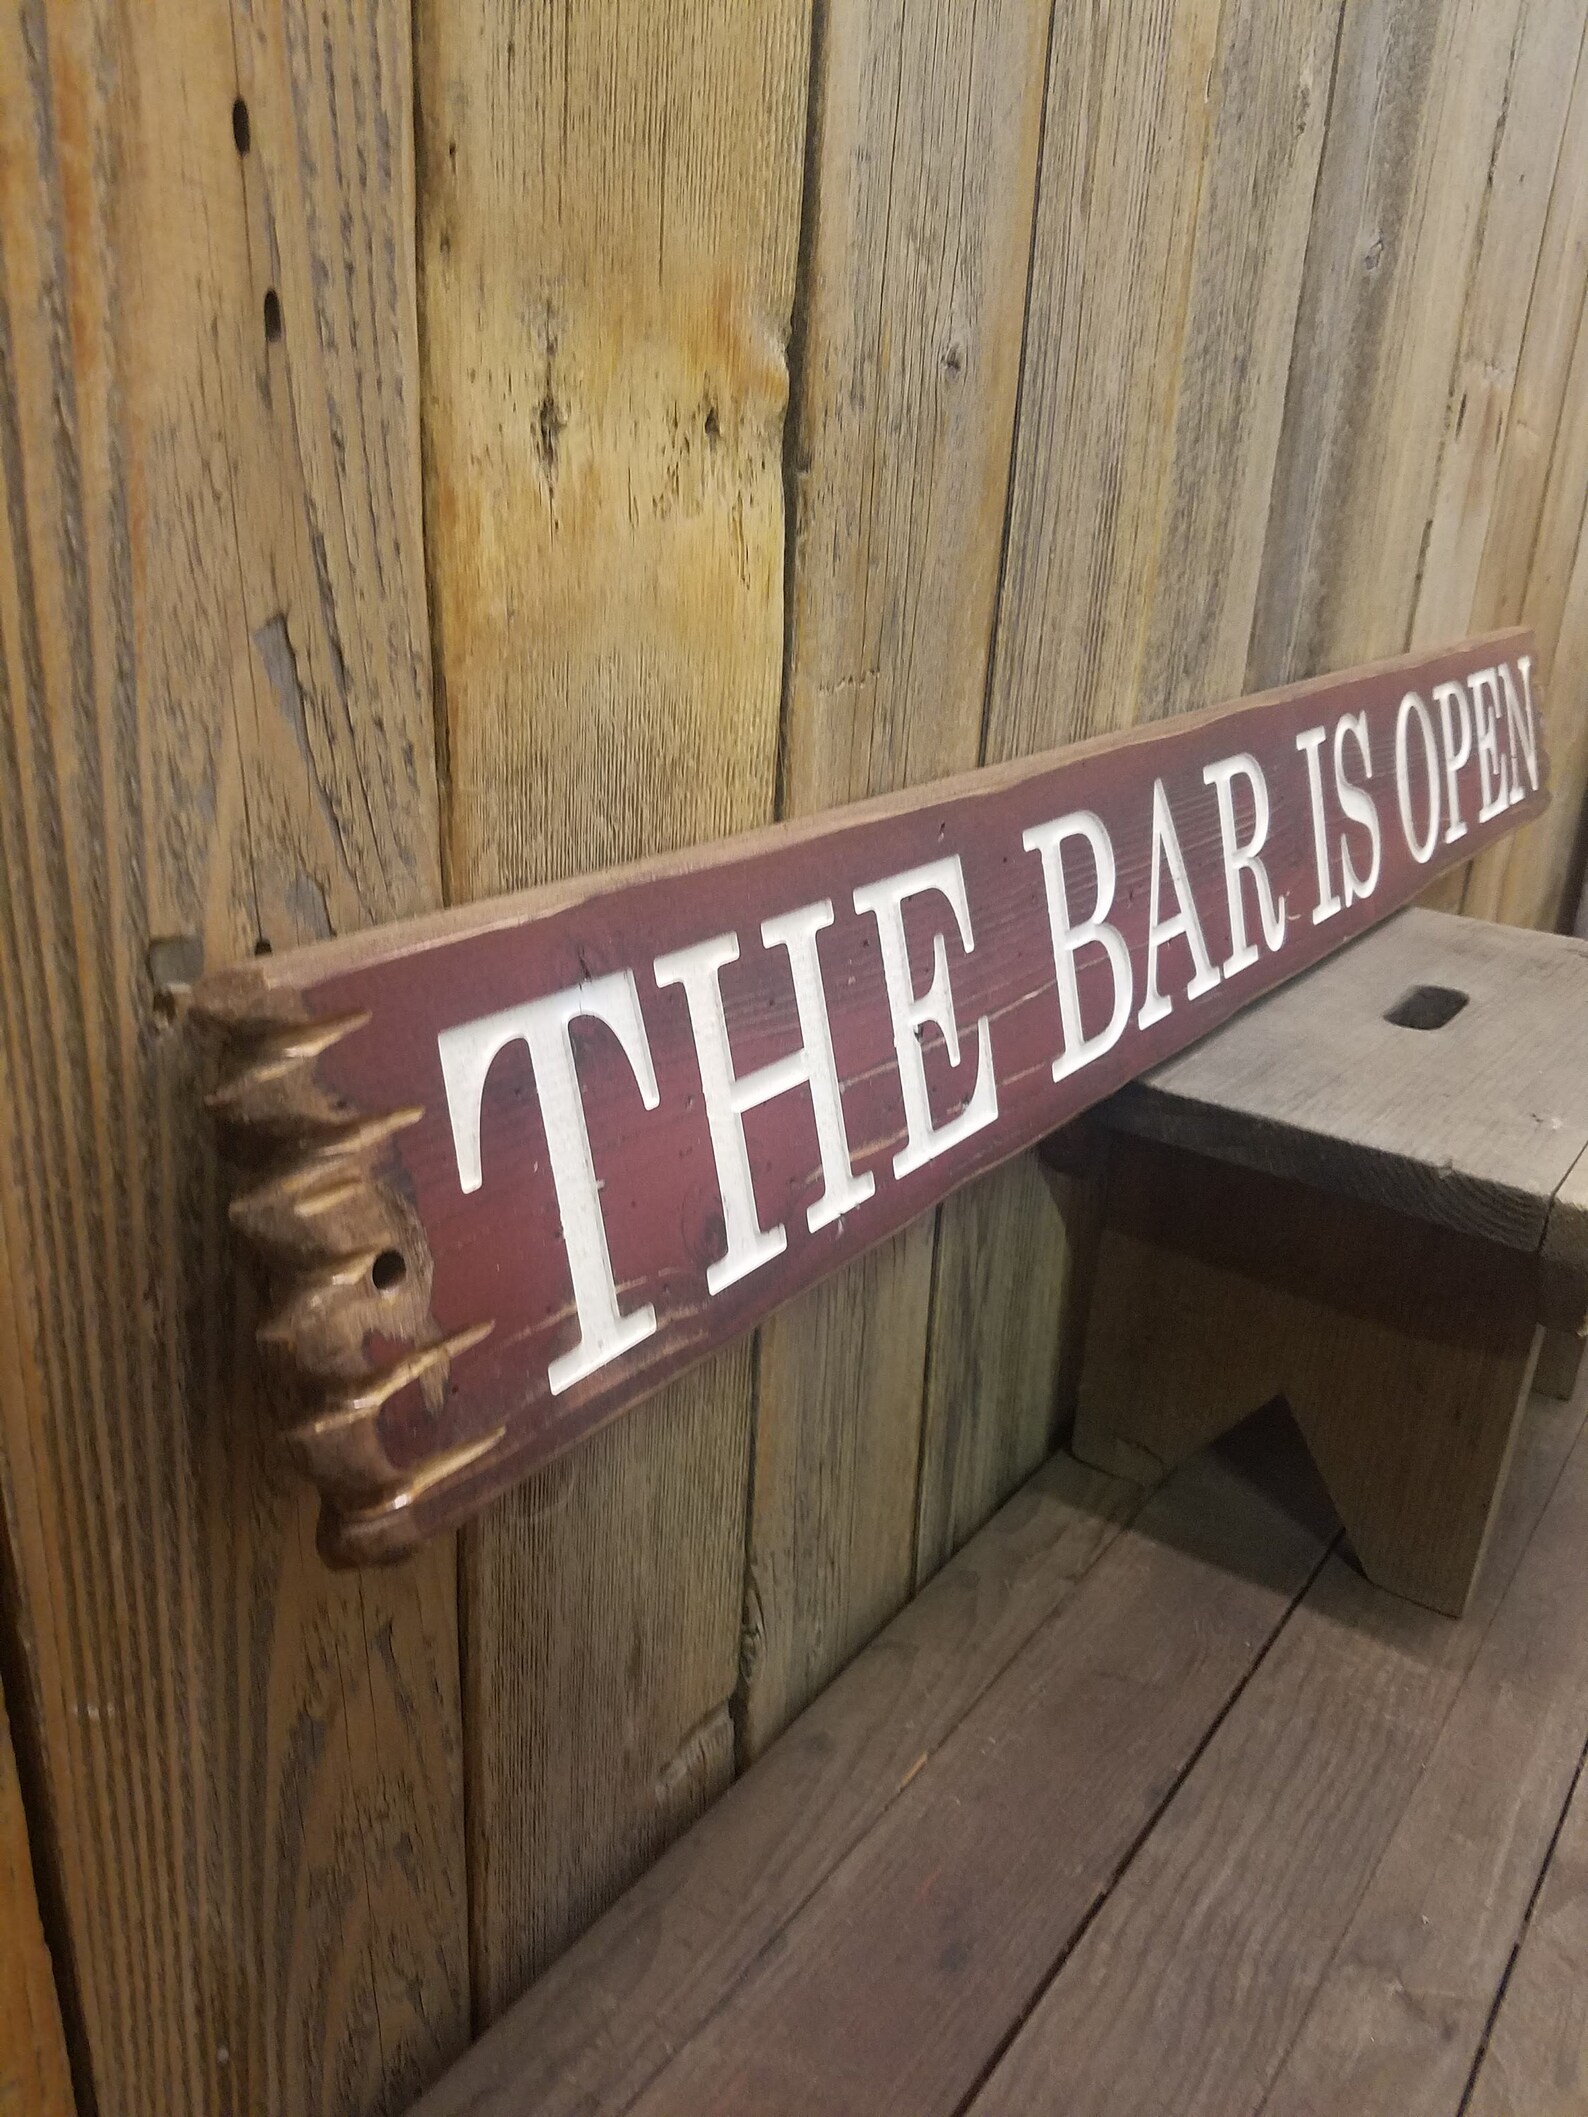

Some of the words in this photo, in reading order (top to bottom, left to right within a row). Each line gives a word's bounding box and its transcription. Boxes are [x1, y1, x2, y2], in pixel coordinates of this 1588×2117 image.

[437, 854, 999, 1396] THE
[1022, 752, 1286, 1083] BAR
[1295, 709, 1382, 926] IS
[1395, 655, 1539, 864] OPEN
